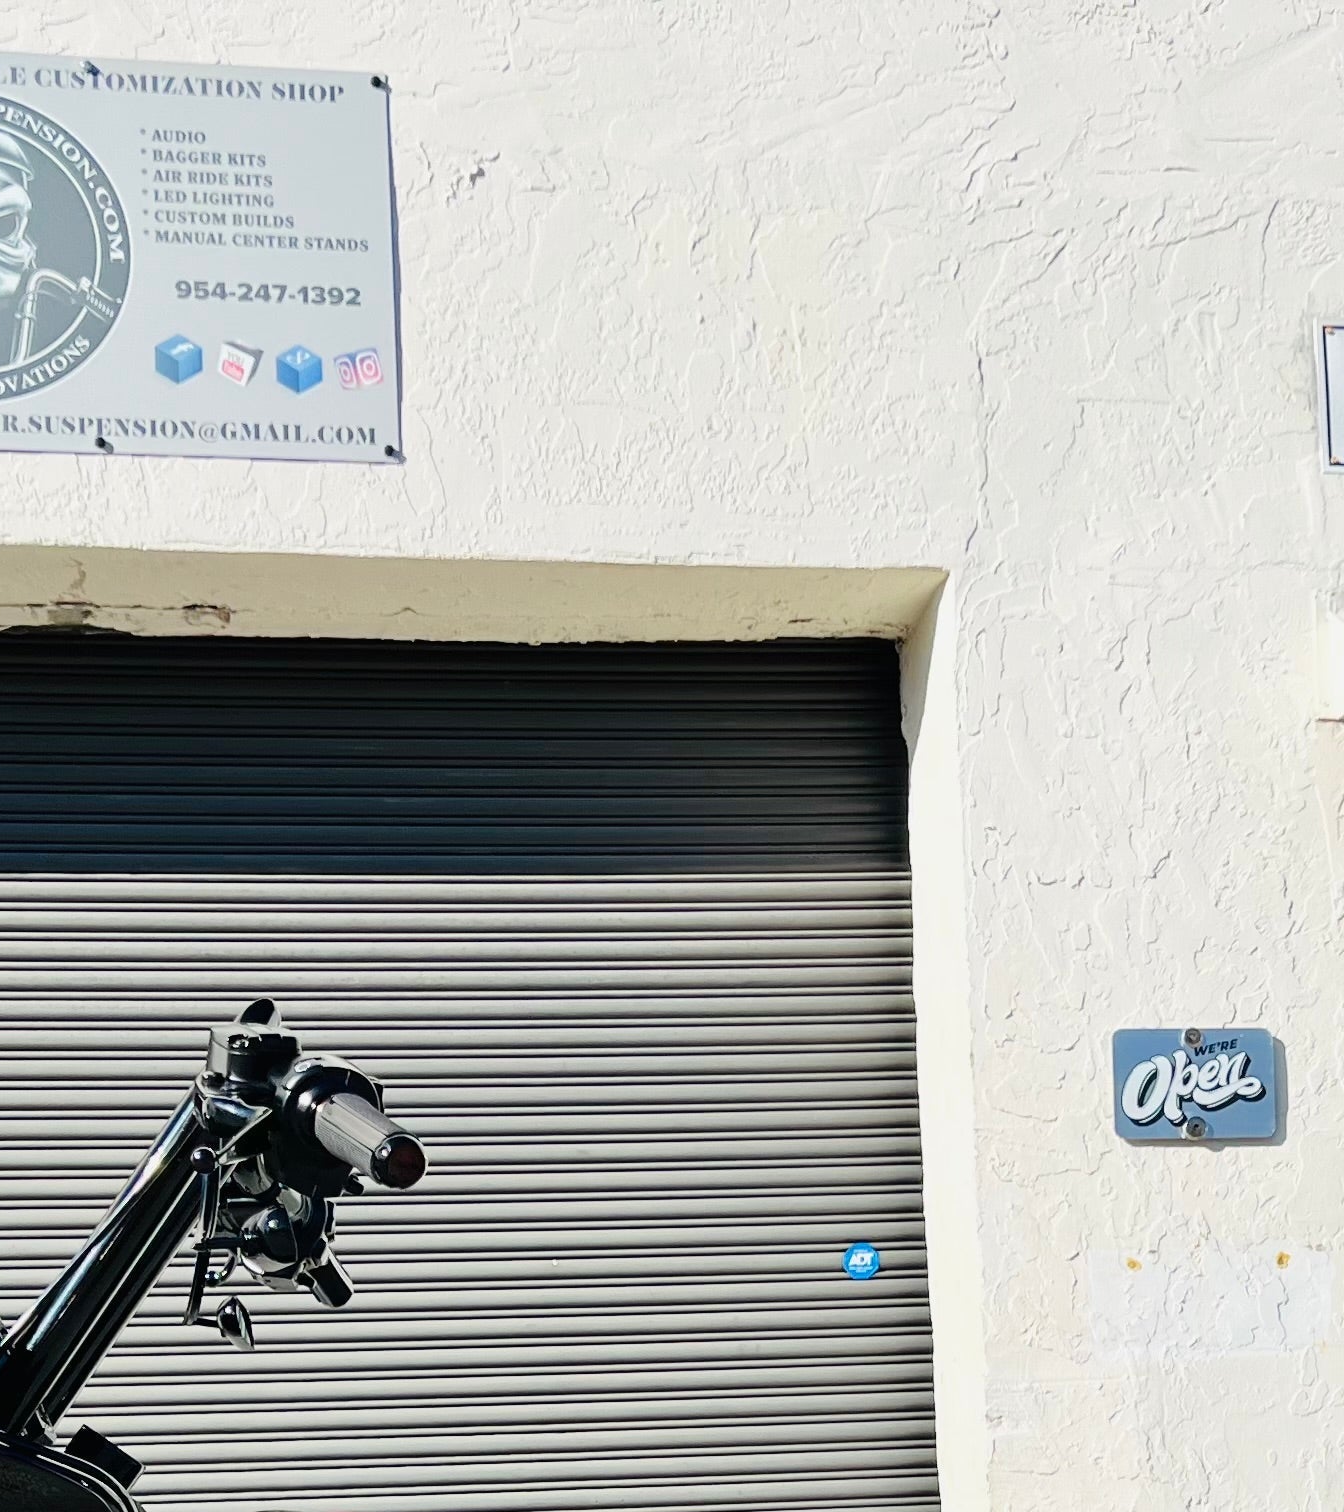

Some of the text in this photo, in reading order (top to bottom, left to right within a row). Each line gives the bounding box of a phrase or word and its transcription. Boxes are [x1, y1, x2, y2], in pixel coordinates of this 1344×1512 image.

[34, 69, 263, 101] CUSTOMIZATION
[271, 82, 345, 105] SHOP
[152, 129, 207, 144] AUDIO
[152, 149, 267, 168] BAGGER KITS
[152, 169, 273, 188] AIR RIDE KITS
[153, 189, 275, 208] LED LIGHTING
[154, 210, 295, 229] CUSTOM BUILDS
[155, 230, 369, 252] MANUAL CENTER STANDS
[175, 280, 363, 308] 954-247-1392
[1194, 1039, 1238, 1057] WE'RE
[1121, 1049, 1259, 1127] Open
[848, 1252, 875, 1267] ADT
